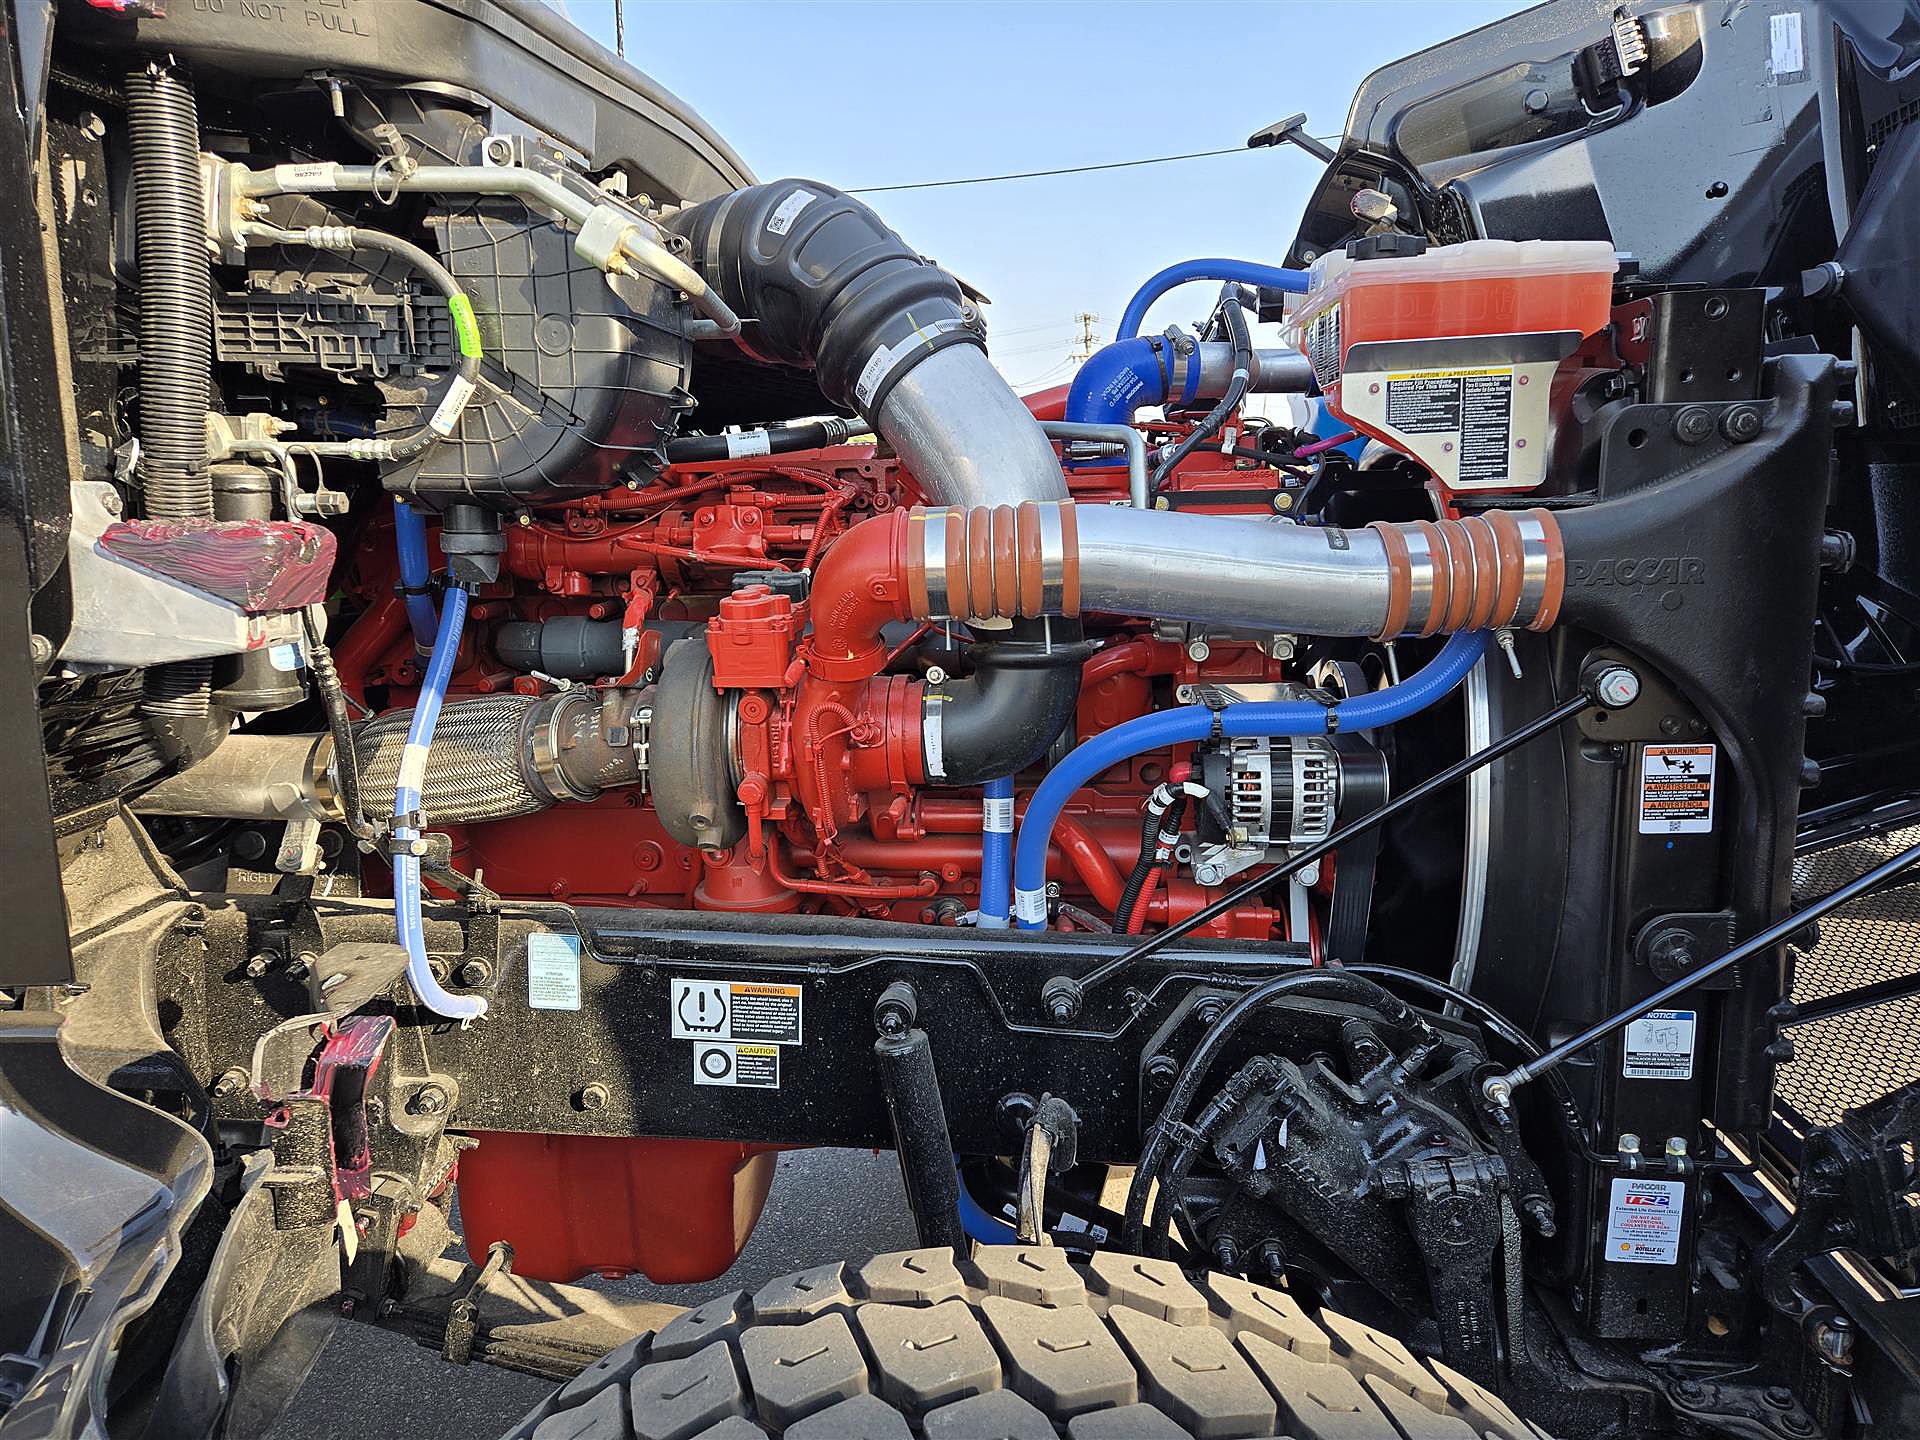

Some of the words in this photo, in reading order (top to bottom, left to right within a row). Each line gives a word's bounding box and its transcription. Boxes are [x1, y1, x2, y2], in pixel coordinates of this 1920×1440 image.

[240, 0, 286, 22] NOT
[305, 10, 369, 37] PULL
[1567, 557, 1705, 586] PACCAR
[1667, 747, 1699, 755] WARNING
[238, 872, 273, 883] RIGHT
[750, 986, 785, 995] WARNING
[1631, 1183, 1666, 1191] PACCAR
